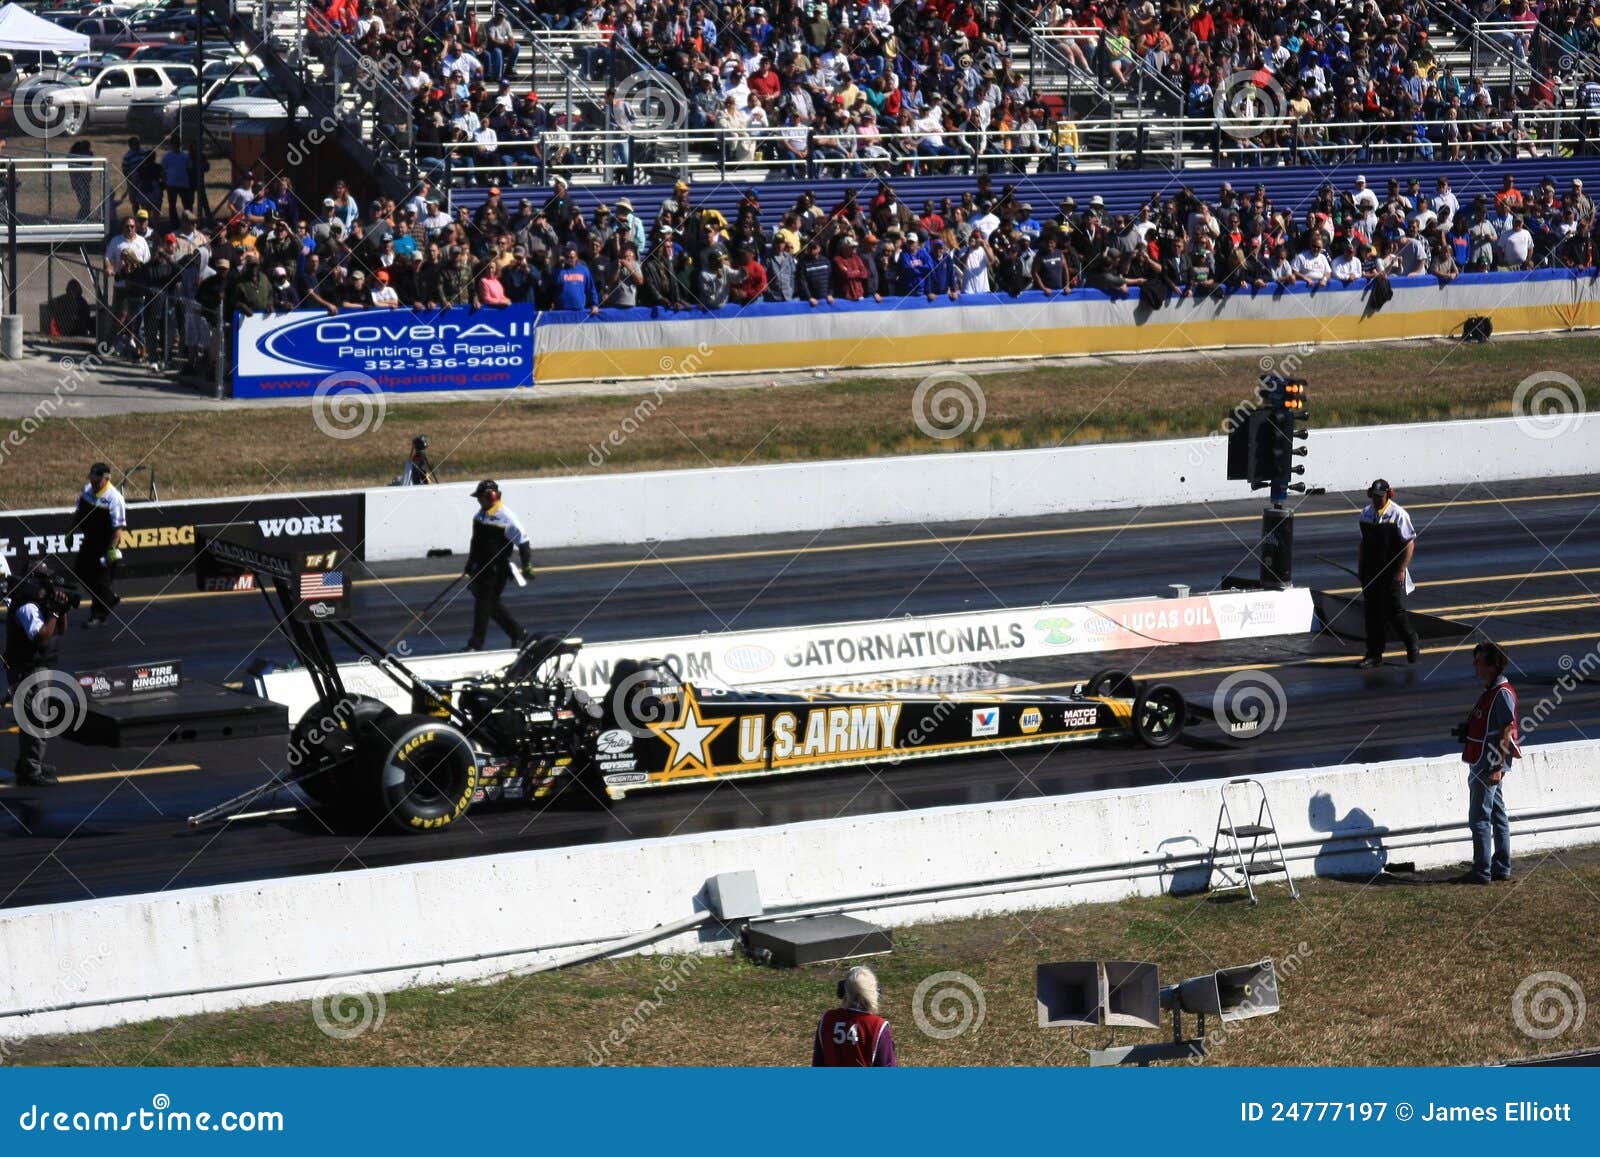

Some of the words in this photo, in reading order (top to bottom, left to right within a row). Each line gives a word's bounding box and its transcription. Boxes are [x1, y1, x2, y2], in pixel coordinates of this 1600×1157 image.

[338, 344, 423, 358] Painting
[429, 344, 447, 355] &
[454, 342, 522, 355] Repair
[364, 356, 523, 370] 352-336-9400
[118, 525, 195, 549] NERG
[258, 515, 343, 538] WORK
[1121, 609, 1179, 631] LUCAS
[1184, 607, 1212, 626] OIL
[784, 622, 1025, 668] GATORNATIONALS
[151, 666, 172, 677] TIRE
[132, 674, 178, 688] KINGDOM
[1023, 714, 1040, 727] NAPA
[1063, 708, 1097, 719] MATCO
[1063, 717, 1097, 727] TOOLS
[398, 731, 436, 761] EAGLE
[833, 1022, 859, 1045] 54
